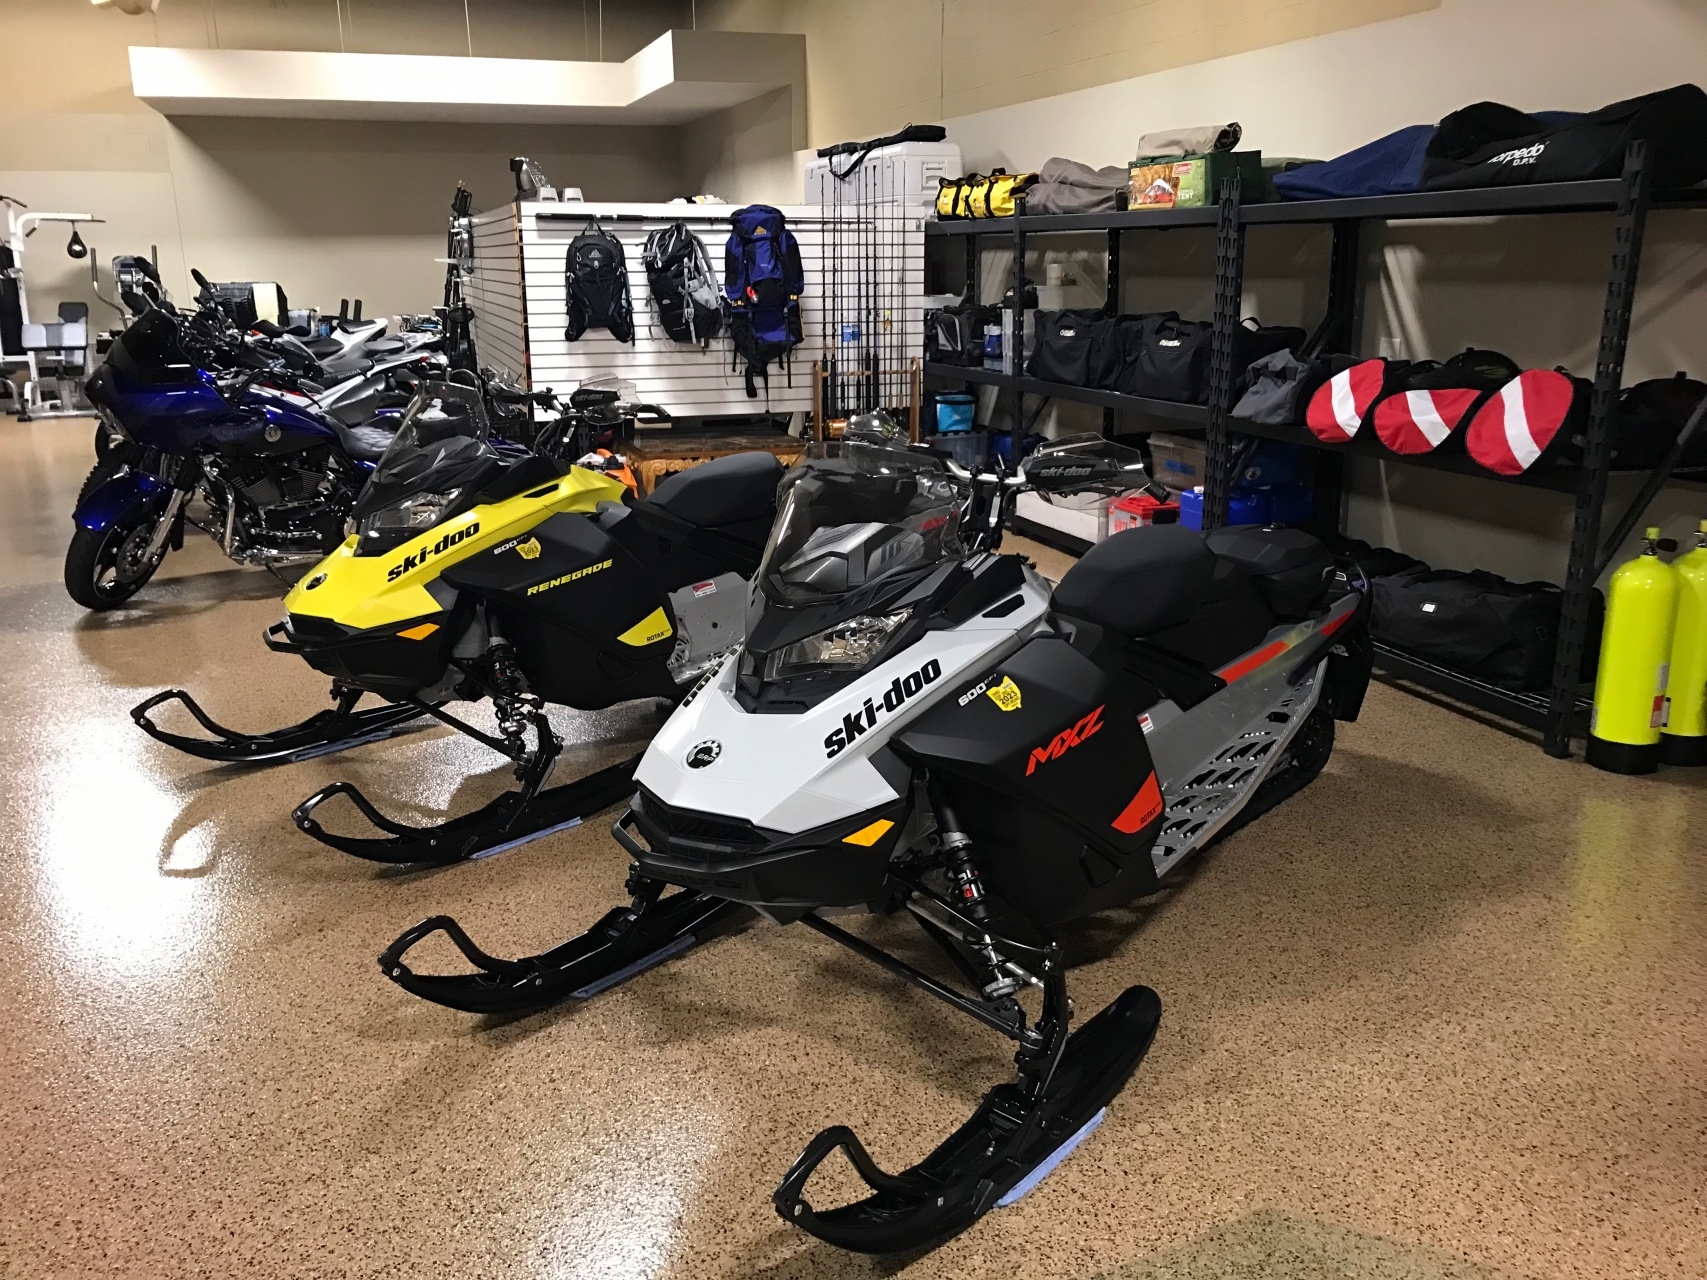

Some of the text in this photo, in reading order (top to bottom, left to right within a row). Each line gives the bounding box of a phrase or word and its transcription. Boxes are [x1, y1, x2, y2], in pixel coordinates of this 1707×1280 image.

[1039, 467, 1093, 477] ski-doo
[387, 522, 480, 583] ski-doo
[527, 559, 613, 596] RENEGADE
[646, 631, 666, 642] ROTAX
[823, 658, 942, 759] ski-doo
[999, 690, 1018, 705] 2023
[1025, 704, 1105, 777] MXZ
[1140, 807, 1157, 825] ROTAX
